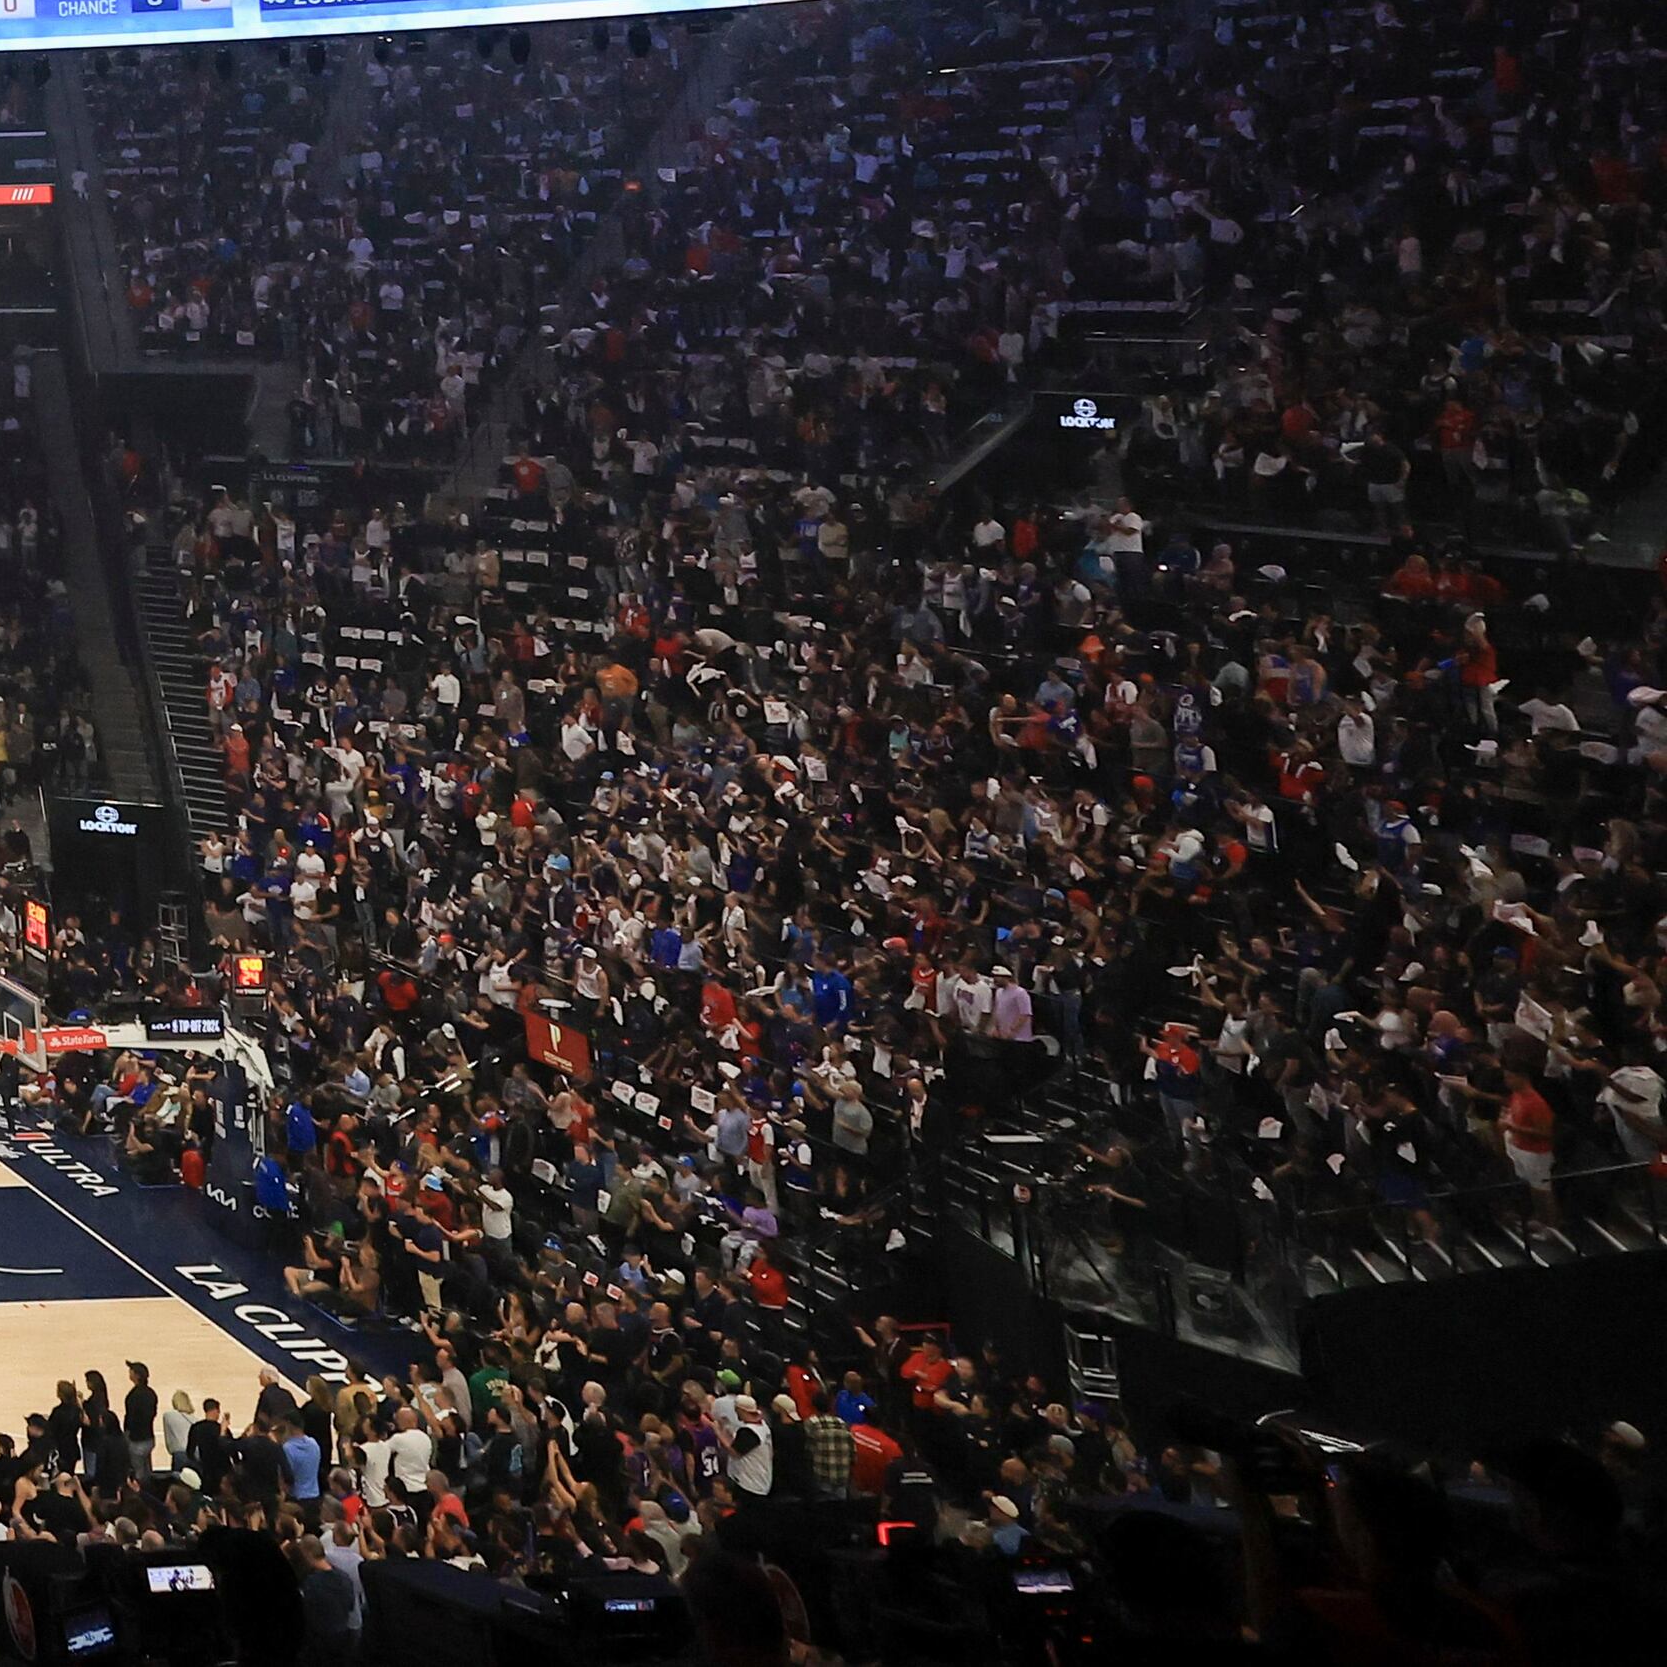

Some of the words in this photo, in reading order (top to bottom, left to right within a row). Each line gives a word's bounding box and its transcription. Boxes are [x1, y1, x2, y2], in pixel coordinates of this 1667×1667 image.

[79, 820, 138, 834] LOCKTON
[27, 1141, 120, 1196] ULTRA
[175, 1264, 249, 1300] LA
